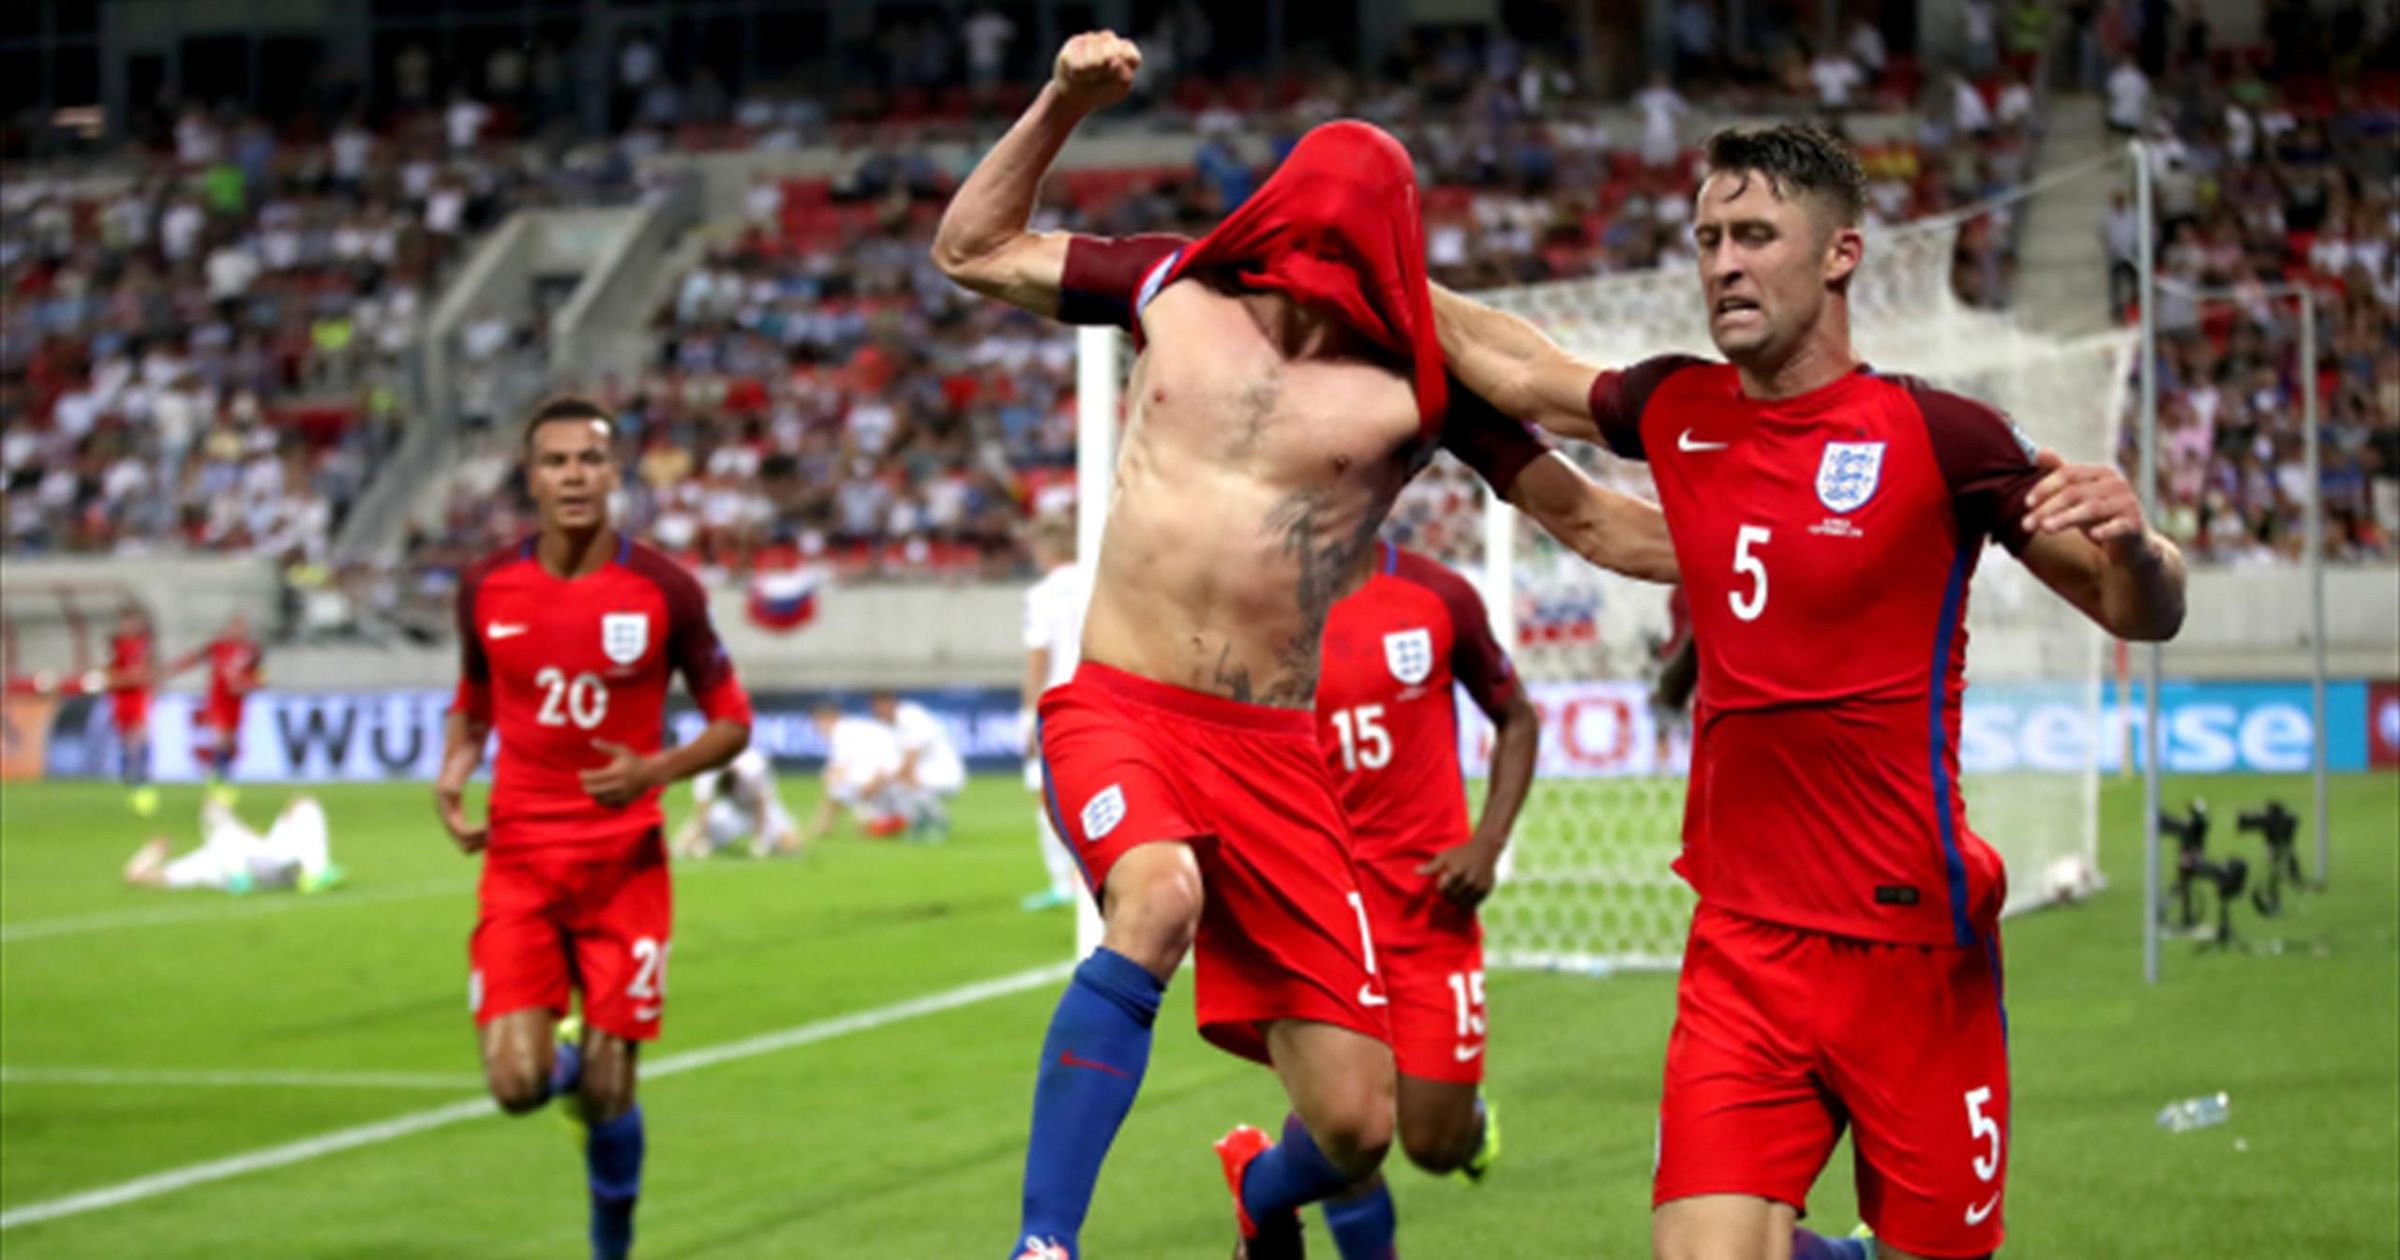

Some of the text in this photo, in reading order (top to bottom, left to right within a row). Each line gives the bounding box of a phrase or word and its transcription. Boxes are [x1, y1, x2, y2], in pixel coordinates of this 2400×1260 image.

[1728, 524, 1771, 621] 5
[535, 667, 607, 729] 20
[1331, 704, 1392, 771] 15
[1964, 1086, 1999, 1181] 5
